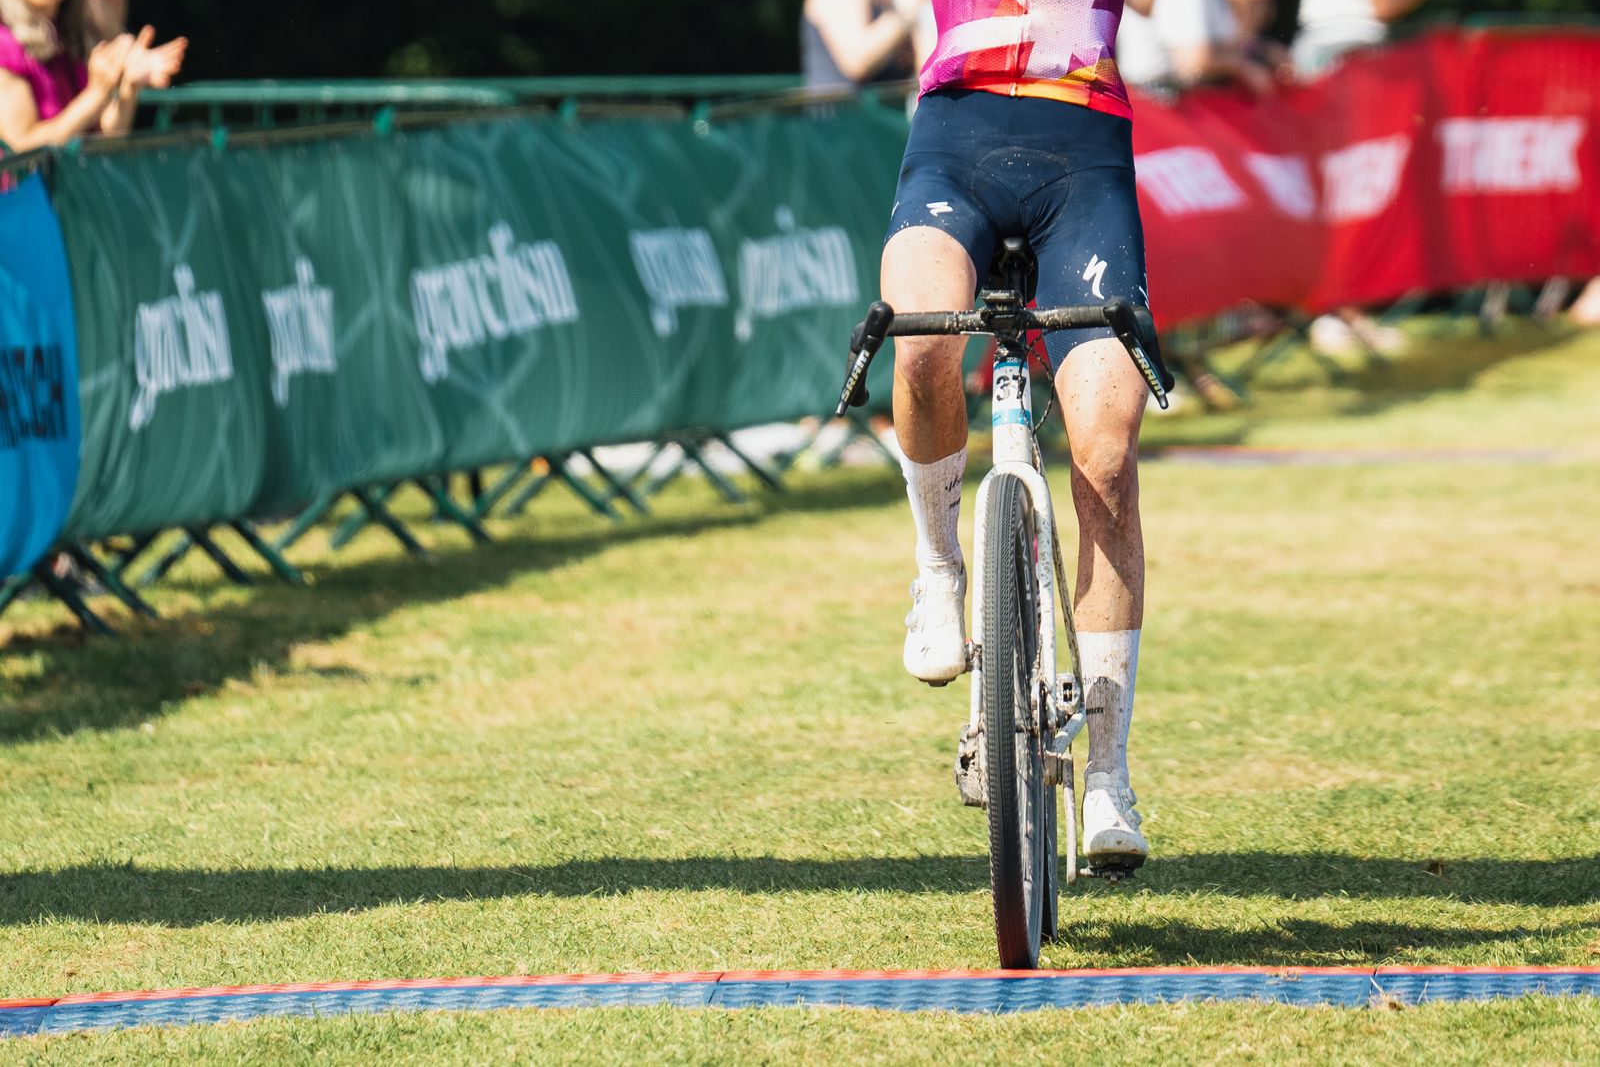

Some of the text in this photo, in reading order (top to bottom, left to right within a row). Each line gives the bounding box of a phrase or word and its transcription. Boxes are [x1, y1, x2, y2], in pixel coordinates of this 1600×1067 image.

[841, 349, 870, 402] SRAM
[996, 375, 1027, 401] 37
[1131, 347, 1166, 397] SRAM
